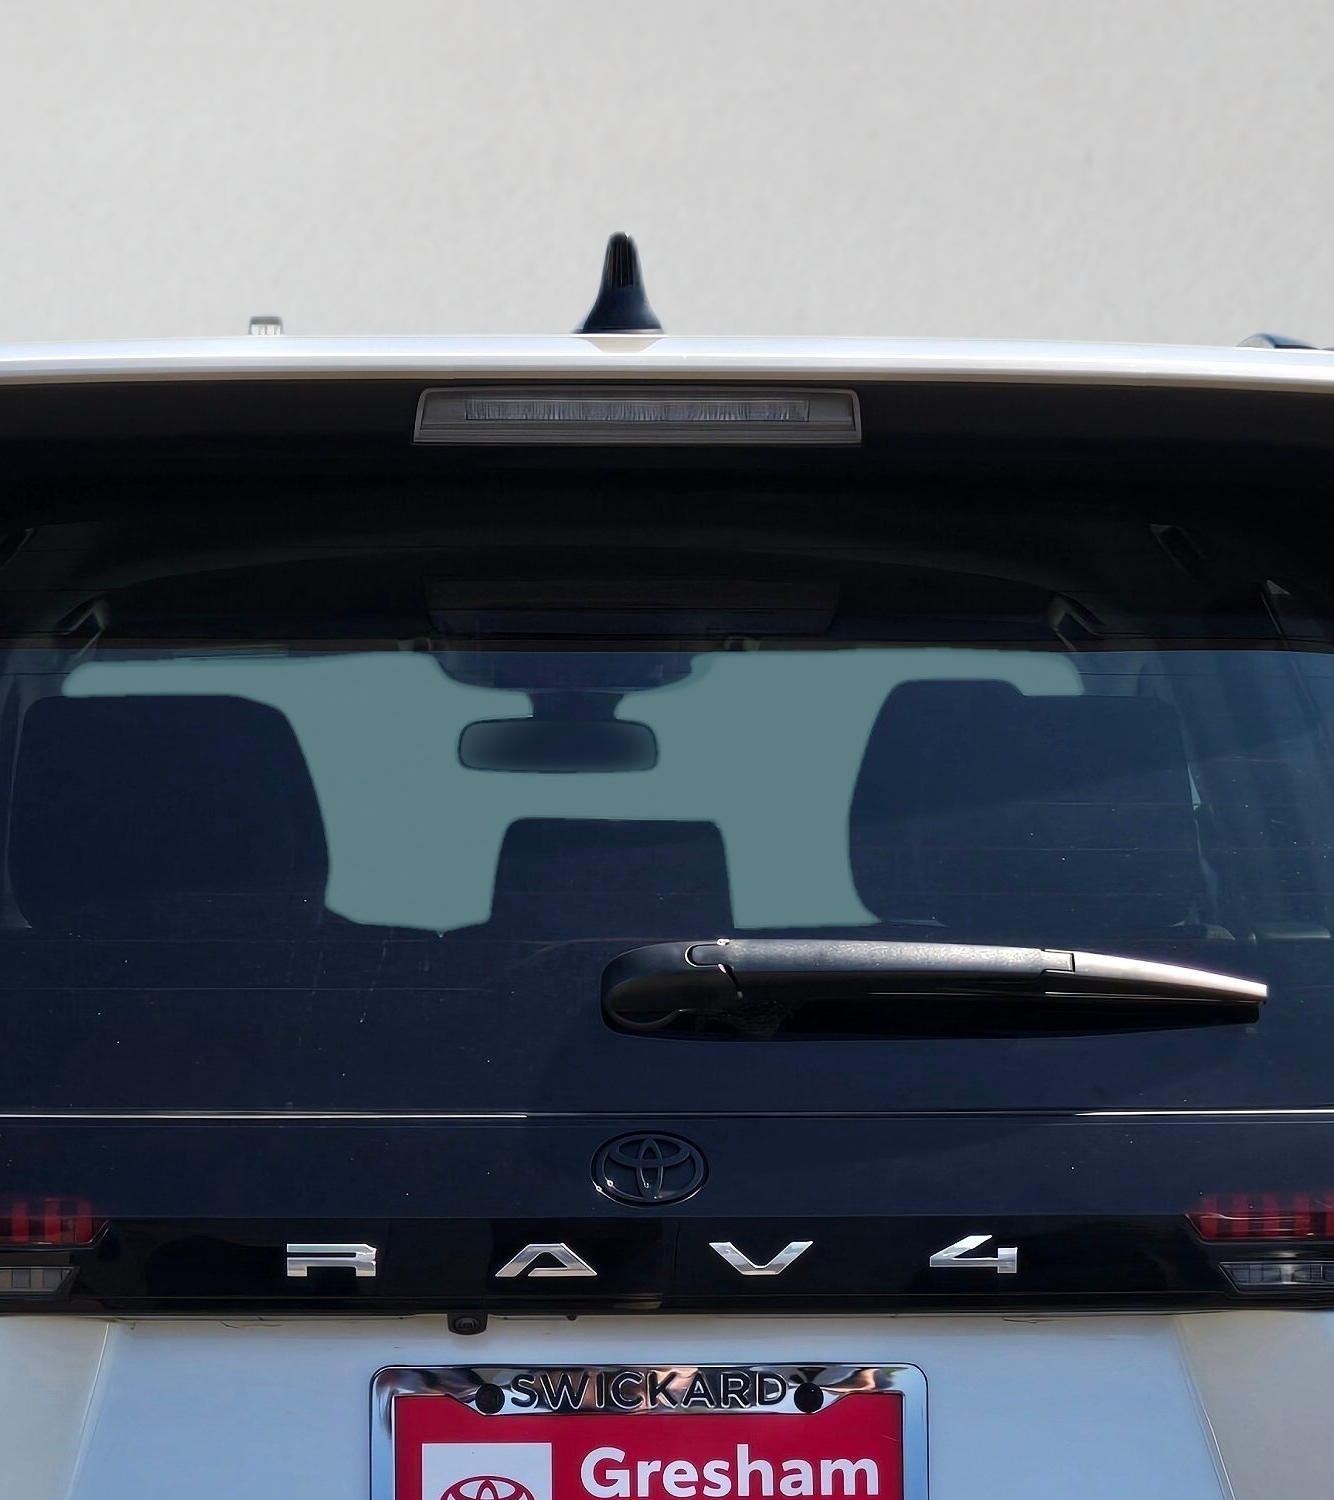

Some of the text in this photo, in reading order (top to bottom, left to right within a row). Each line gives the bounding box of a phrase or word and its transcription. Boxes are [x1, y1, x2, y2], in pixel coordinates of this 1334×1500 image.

[286, 1234, 1018, 1278] RAV4
[510, 1370, 788, 1411] SWICKARD
[580, 1443, 879, 1499] Gresham
